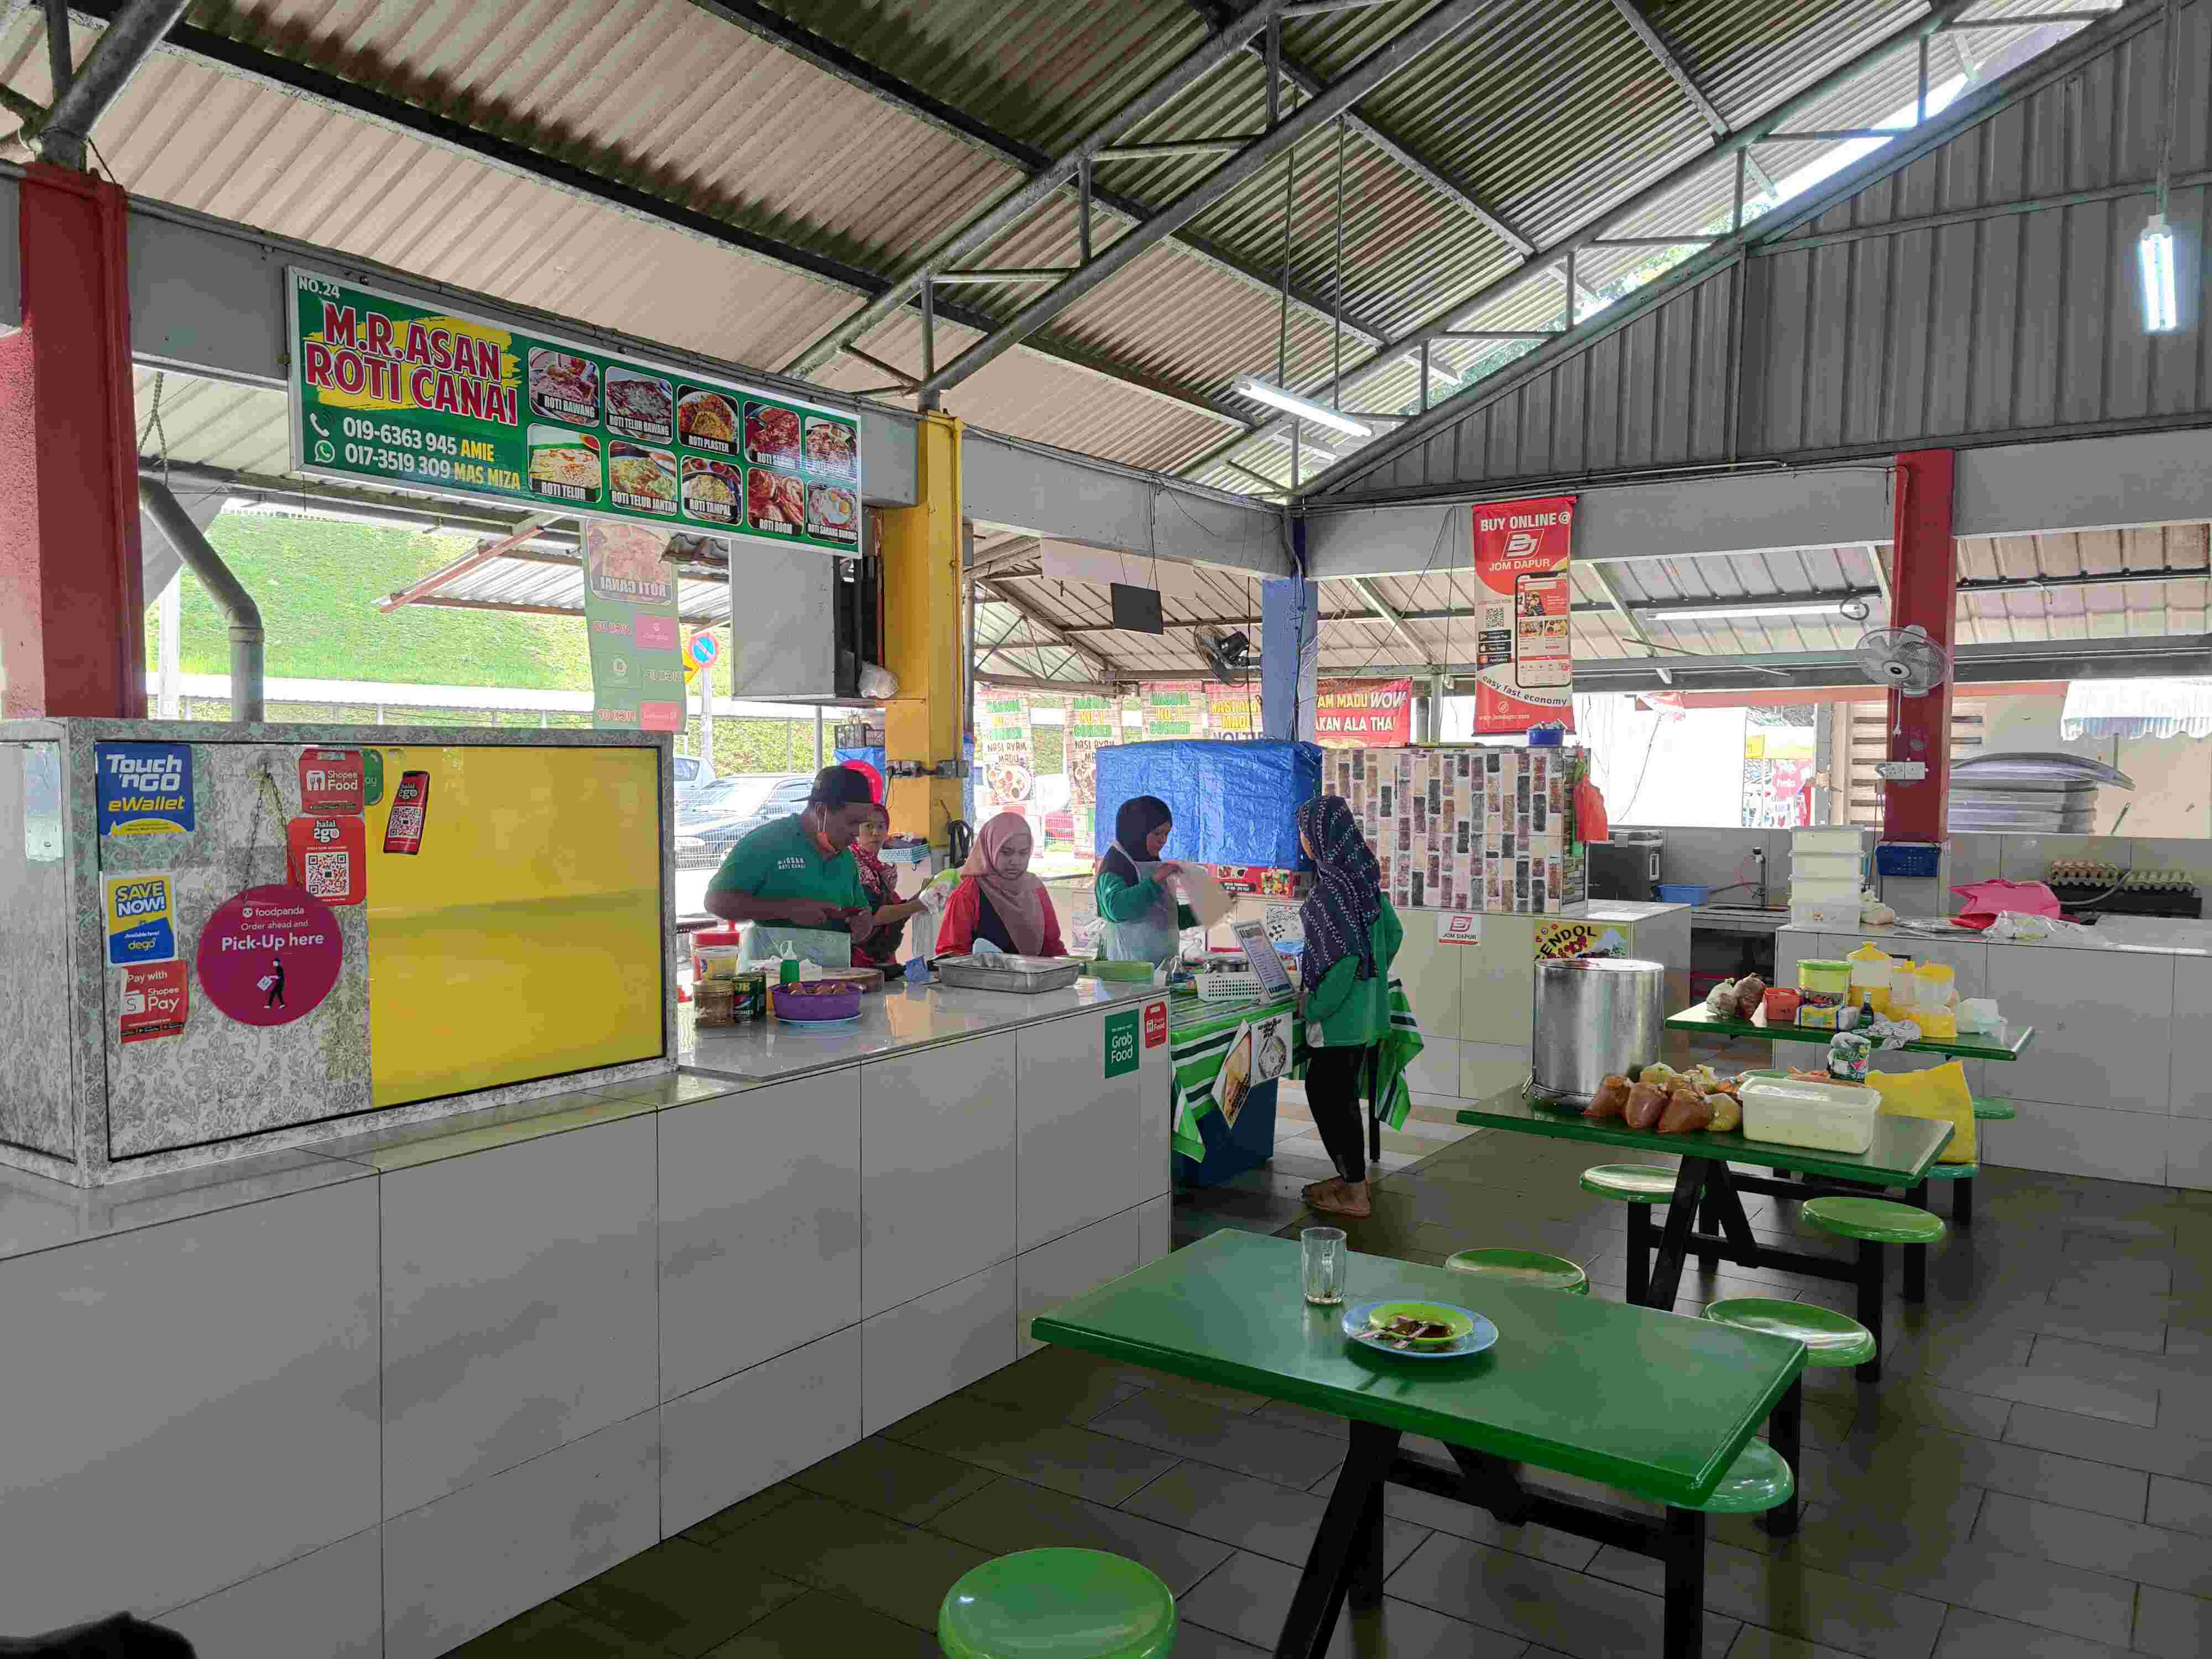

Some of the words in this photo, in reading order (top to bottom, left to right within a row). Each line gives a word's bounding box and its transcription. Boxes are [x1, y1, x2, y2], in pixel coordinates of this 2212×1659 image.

[299, 276, 340, 299] NO.24
[304, 340, 402, 404] ROTI
[410, 366, 518, 426] CANAI
[544, 395, 562, 409] ROTI
[563, 399, 595, 417] BAWANG
[609, 415, 624, 427] ROTI
[643, 421, 669, 436] BAWANG
[343, 416, 422, 450] 019-6363
[425, 431, 457, 455] 945
[460, 439, 495, 462] AMIE
[688, 435, 704, 447] ROTI
[704, 437, 729, 452] PLASTER
[345, 442, 415, 472] 017-3519
[418, 455, 451, 479] 309
[454, 461, 484, 485] MAS
[487, 467, 521, 491] MIZA
[541, 481, 560, 495] ROTI
[562, 484, 586, 500] TELUR
[611, 490, 629, 504] ROTI
[690, 498, 706, 512] ROTI
[759, 519, 774, 531] ROTI
[1480, 517, 1506, 531] BUY
[1509, 513, 1557, 530] ONLINE
[1558, 512, 1571, 525] @
[1489, 561, 1511, 571] JOM
[1514, 558, 1551, 570] DAPUR
[1482, 675, 1502, 690] easy
[1504, 685, 1521, 697] fast
[1524, 693, 1567, 707] economy
[1315, 693, 1334, 708] AM
[1335, 693, 1368, 708] MADU
[1370, 691, 1407, 708] WOW
[1343, 716, 1367, 731] ALA
[987, 743, 1004, 753] NASI
[1006, 740, 1027, 752] AYAM
[1075, 739, 1092, 750] NASI
[106, 754, 182, 774] Touch
[998, 754, 1019, 764] MADU
[327, 770, 359, 779] Shopee
[364, 777, 377, 786] ay
[327, 780, 359, 791] Food
[108, 796, 186, 812] eWallet
[316, 820, 336, 828] halal
[116, 880, 165, 902] SAVE
[116, 895, 166, 918] NOW!
[255, 906, 305, 917] foodpanda
[241, 922, 266, 931] Order
[268, 921, 292, 930] ahead
[293, 920, 309, 928] and
[222, 934, 285, 952] Pick-Up
[289, 932, 325, 947] here
[1535, 925, 1597, 961] ENDOL
[127, 973, 145, 984] Pay
[147, 971, 168, 980] with
[147, 987, 179, 997] Shopee
[147, 997, 180, 1013] Pay
[1112, 1030, 1133, 1049] Grab
[1110, 1044, 1133, 1065] Food
